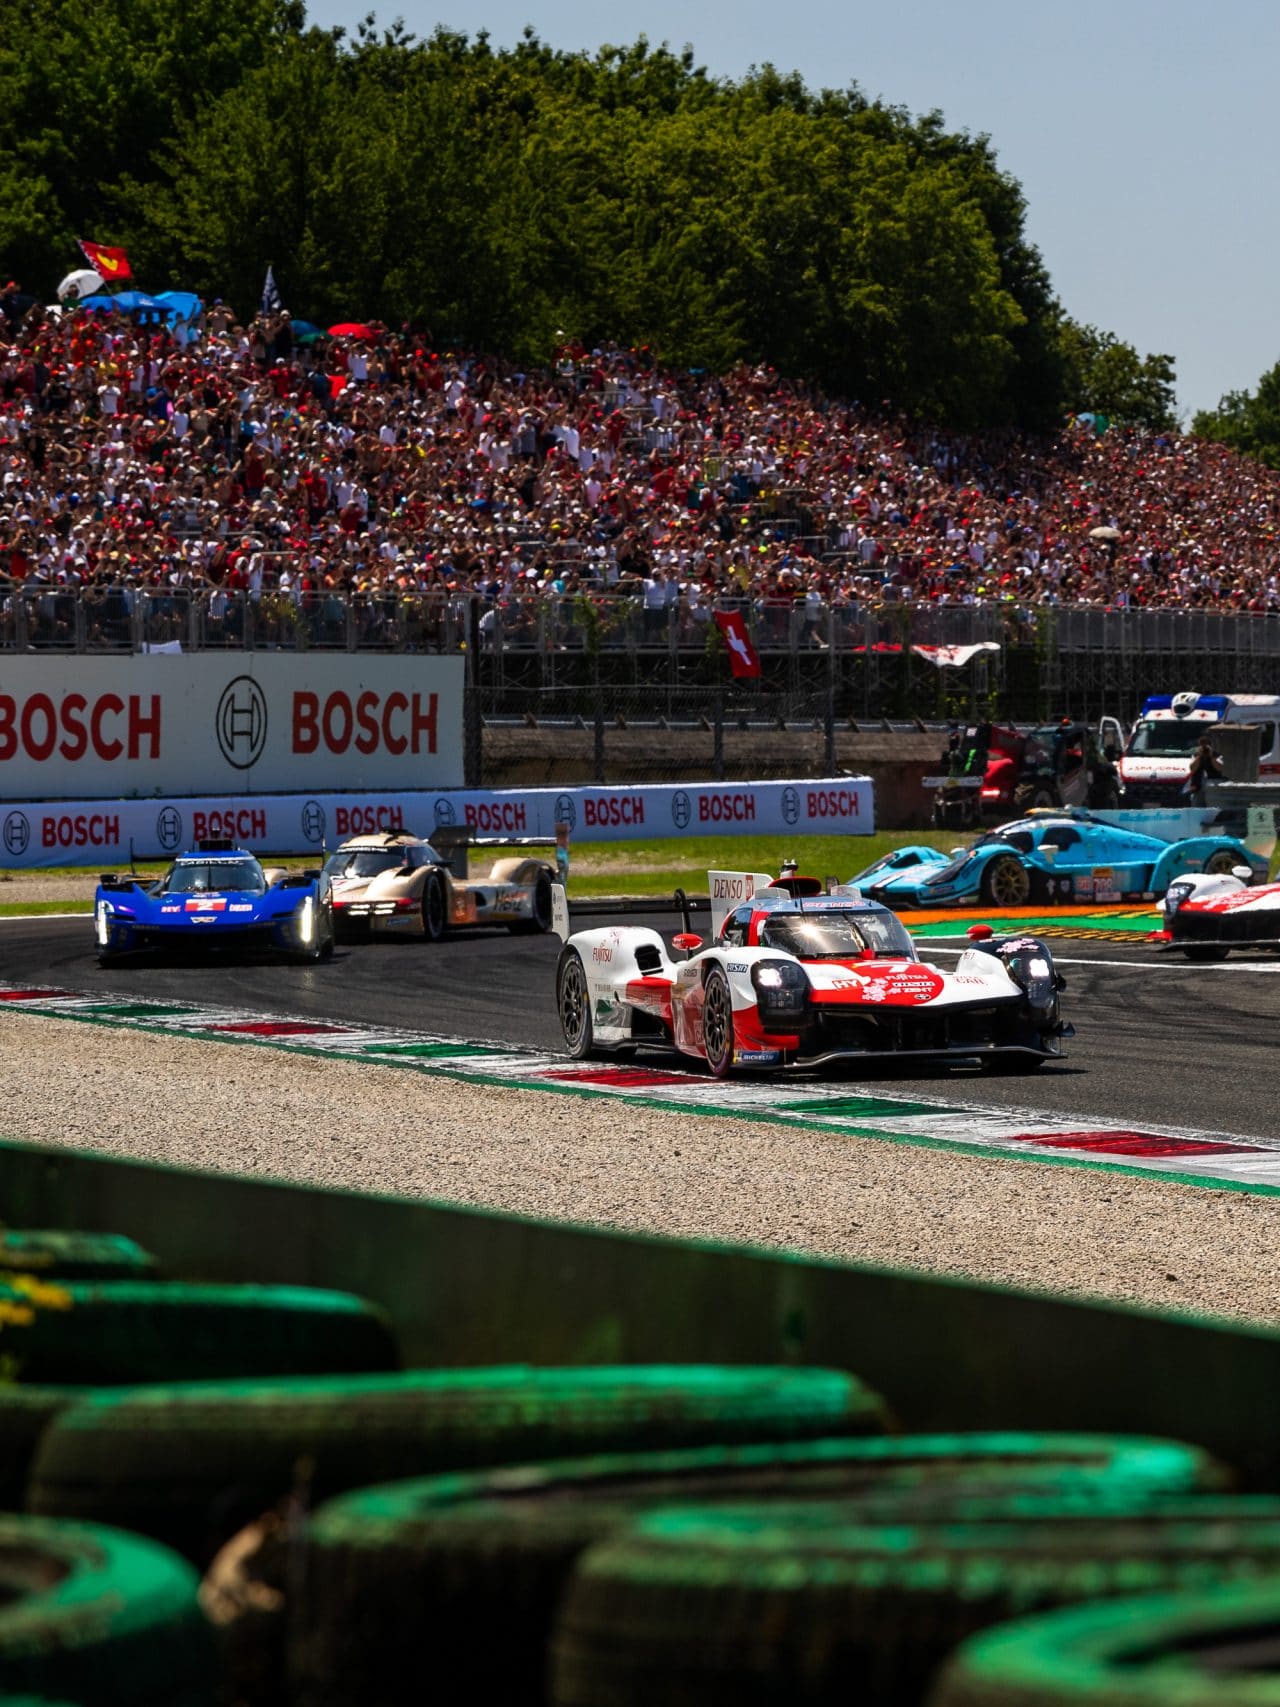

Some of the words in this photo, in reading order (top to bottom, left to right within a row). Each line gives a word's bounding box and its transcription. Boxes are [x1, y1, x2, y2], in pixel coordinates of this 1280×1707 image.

[292, 690, 438, 754] BOSCH
[464, 802, 526, 832] BOSCH
[584, 796, 645, 827] BOSCH
[699, 794, 755, 822] BOSCH
[808, 791, 859, 818] BOSCH
[42, 815, 120, 848] BOSCH
[193, 808, 267, 841] BOSCH
[336, 805, 402, 835] BOSCH
[714, 879, 743, 899] DENSO
[592, 947, 613, 963] FUJITSU
[835, 978, 861, 989] HY
[885, 973, 929, 982] FUJITSU
[743, 1054, 775, 1062] MICHELIN
